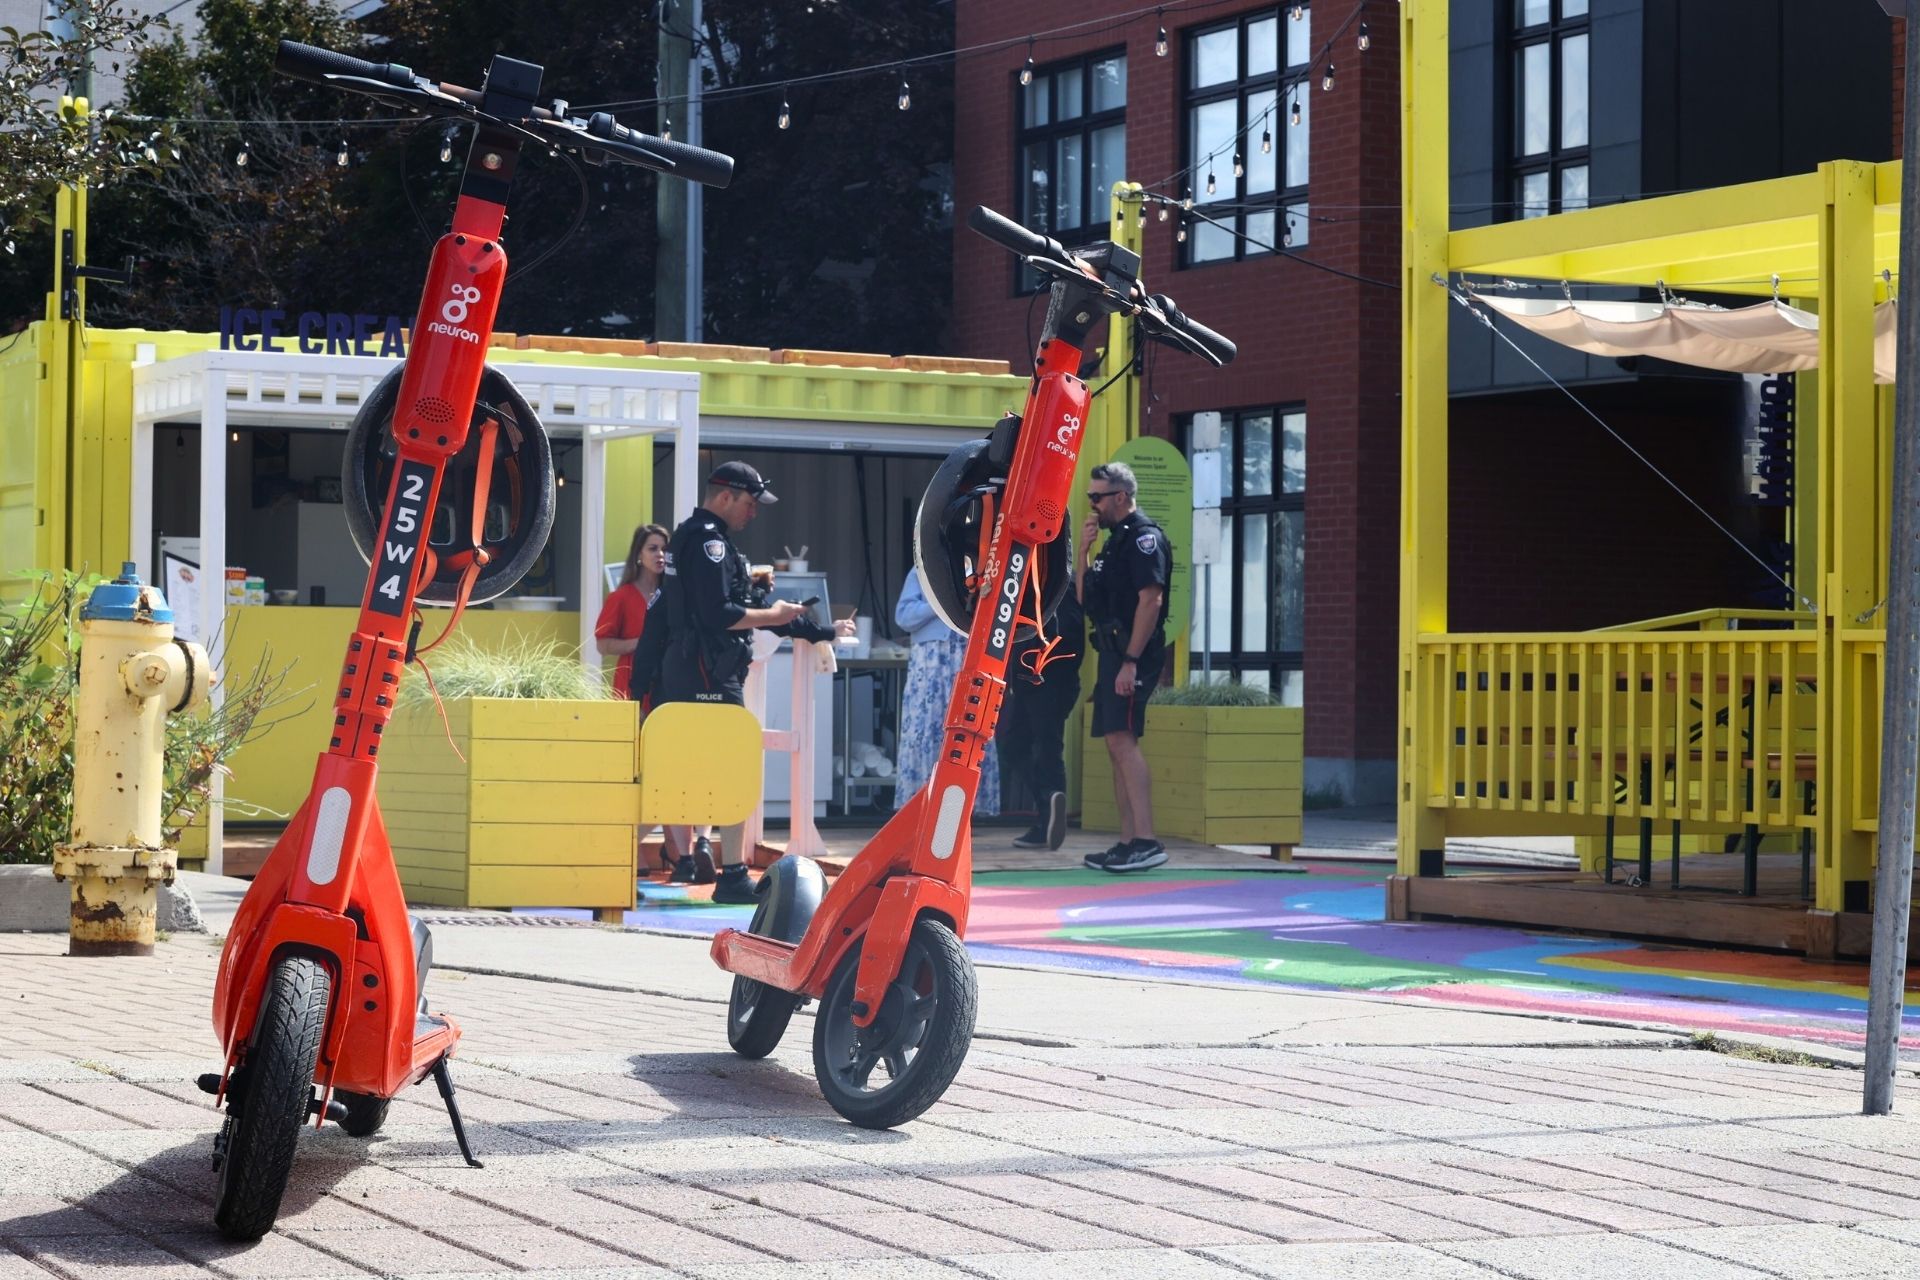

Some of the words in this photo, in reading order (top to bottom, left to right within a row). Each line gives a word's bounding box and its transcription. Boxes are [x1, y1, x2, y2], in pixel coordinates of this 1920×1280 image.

[220, 305, 286, 353] ICE
[298, 311, 417, 358] CREA
[428, 322, 479, 344] neuron
[379, 474, 424, 600] 25W4
[992, 553, 1024, 649] 9Q98
[696, 693, 723, 701] POLICE
